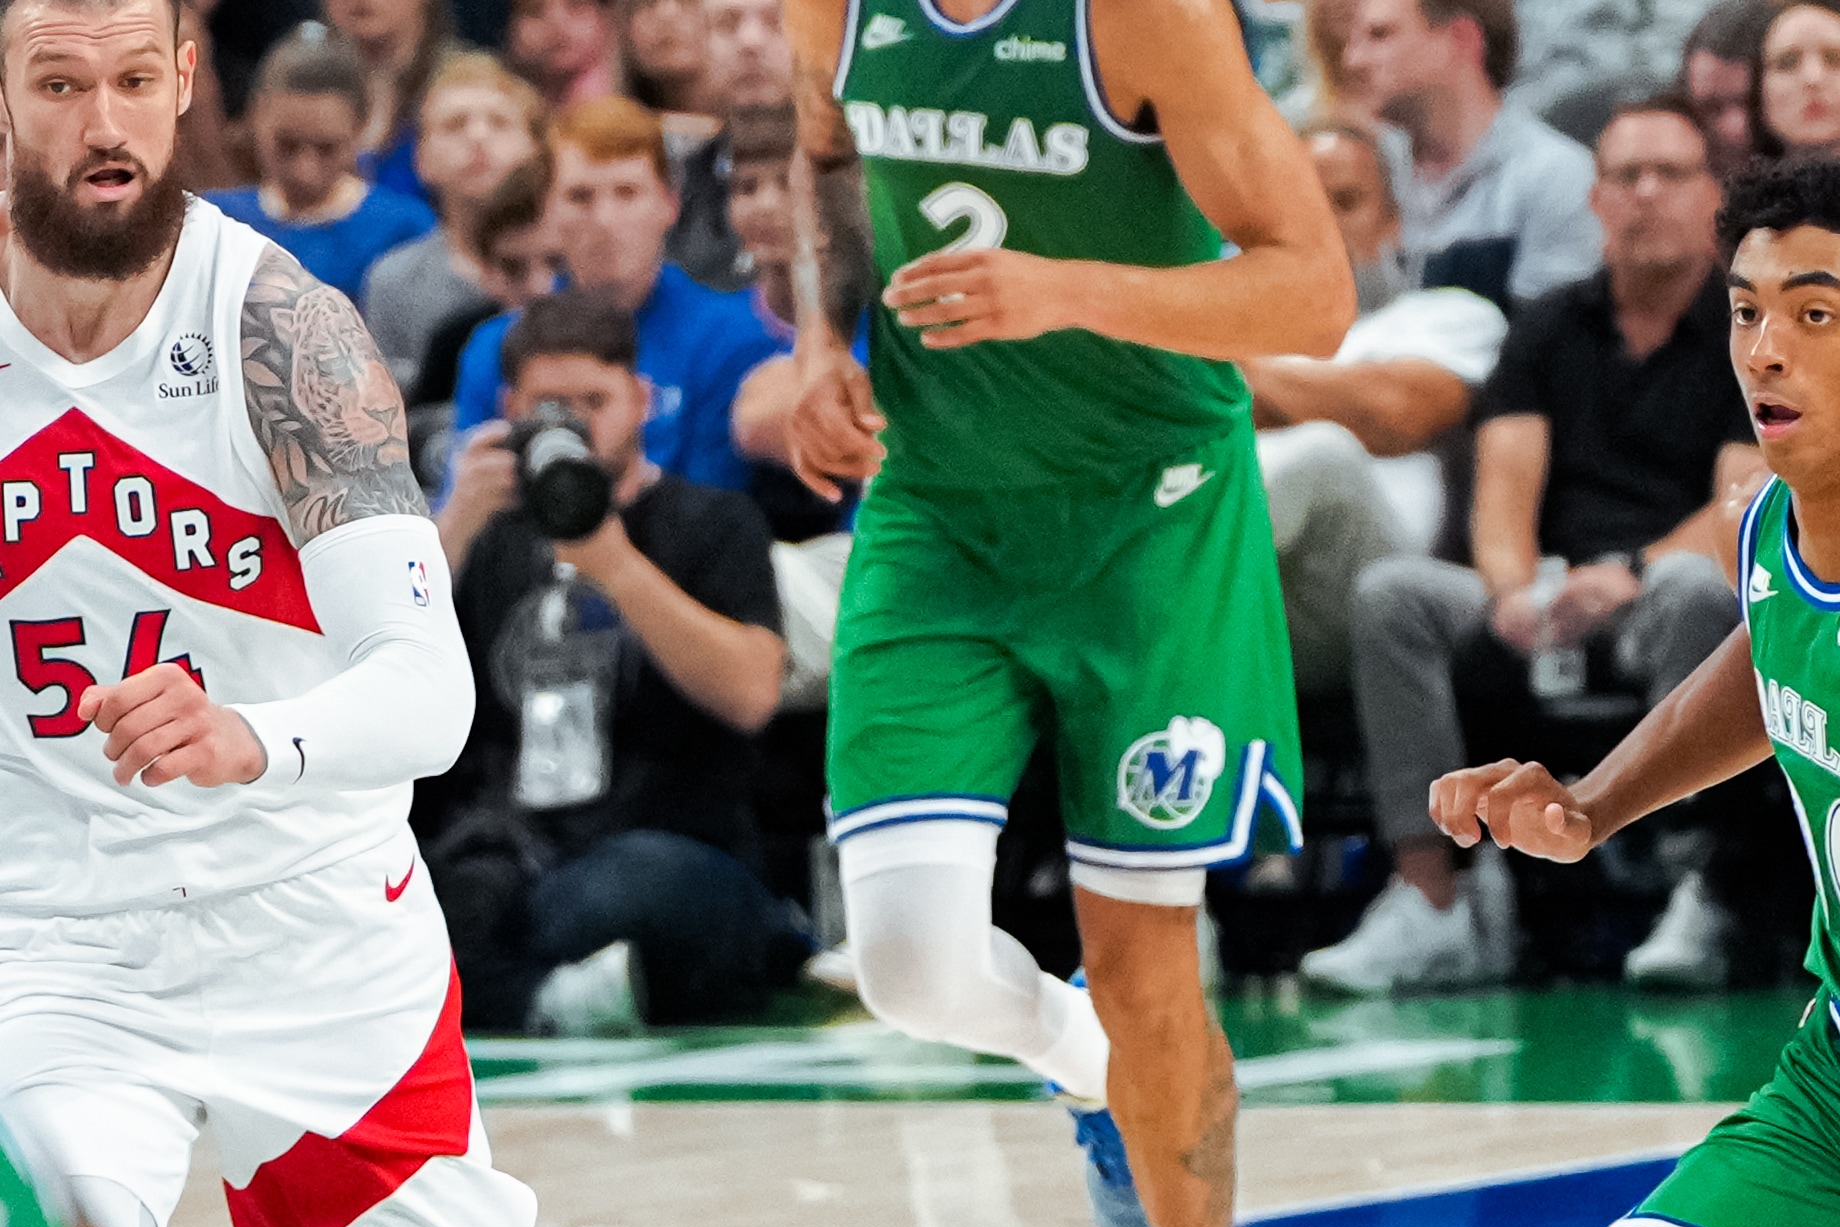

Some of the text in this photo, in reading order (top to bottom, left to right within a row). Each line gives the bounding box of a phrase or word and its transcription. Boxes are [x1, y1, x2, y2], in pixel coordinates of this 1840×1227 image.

[845, 101, 1090, 176] DALLAS
[918, 181, 1008, 256] 2
[158, 382, 193, 399] Sun
[0, 451, 264, 592] PTORS
